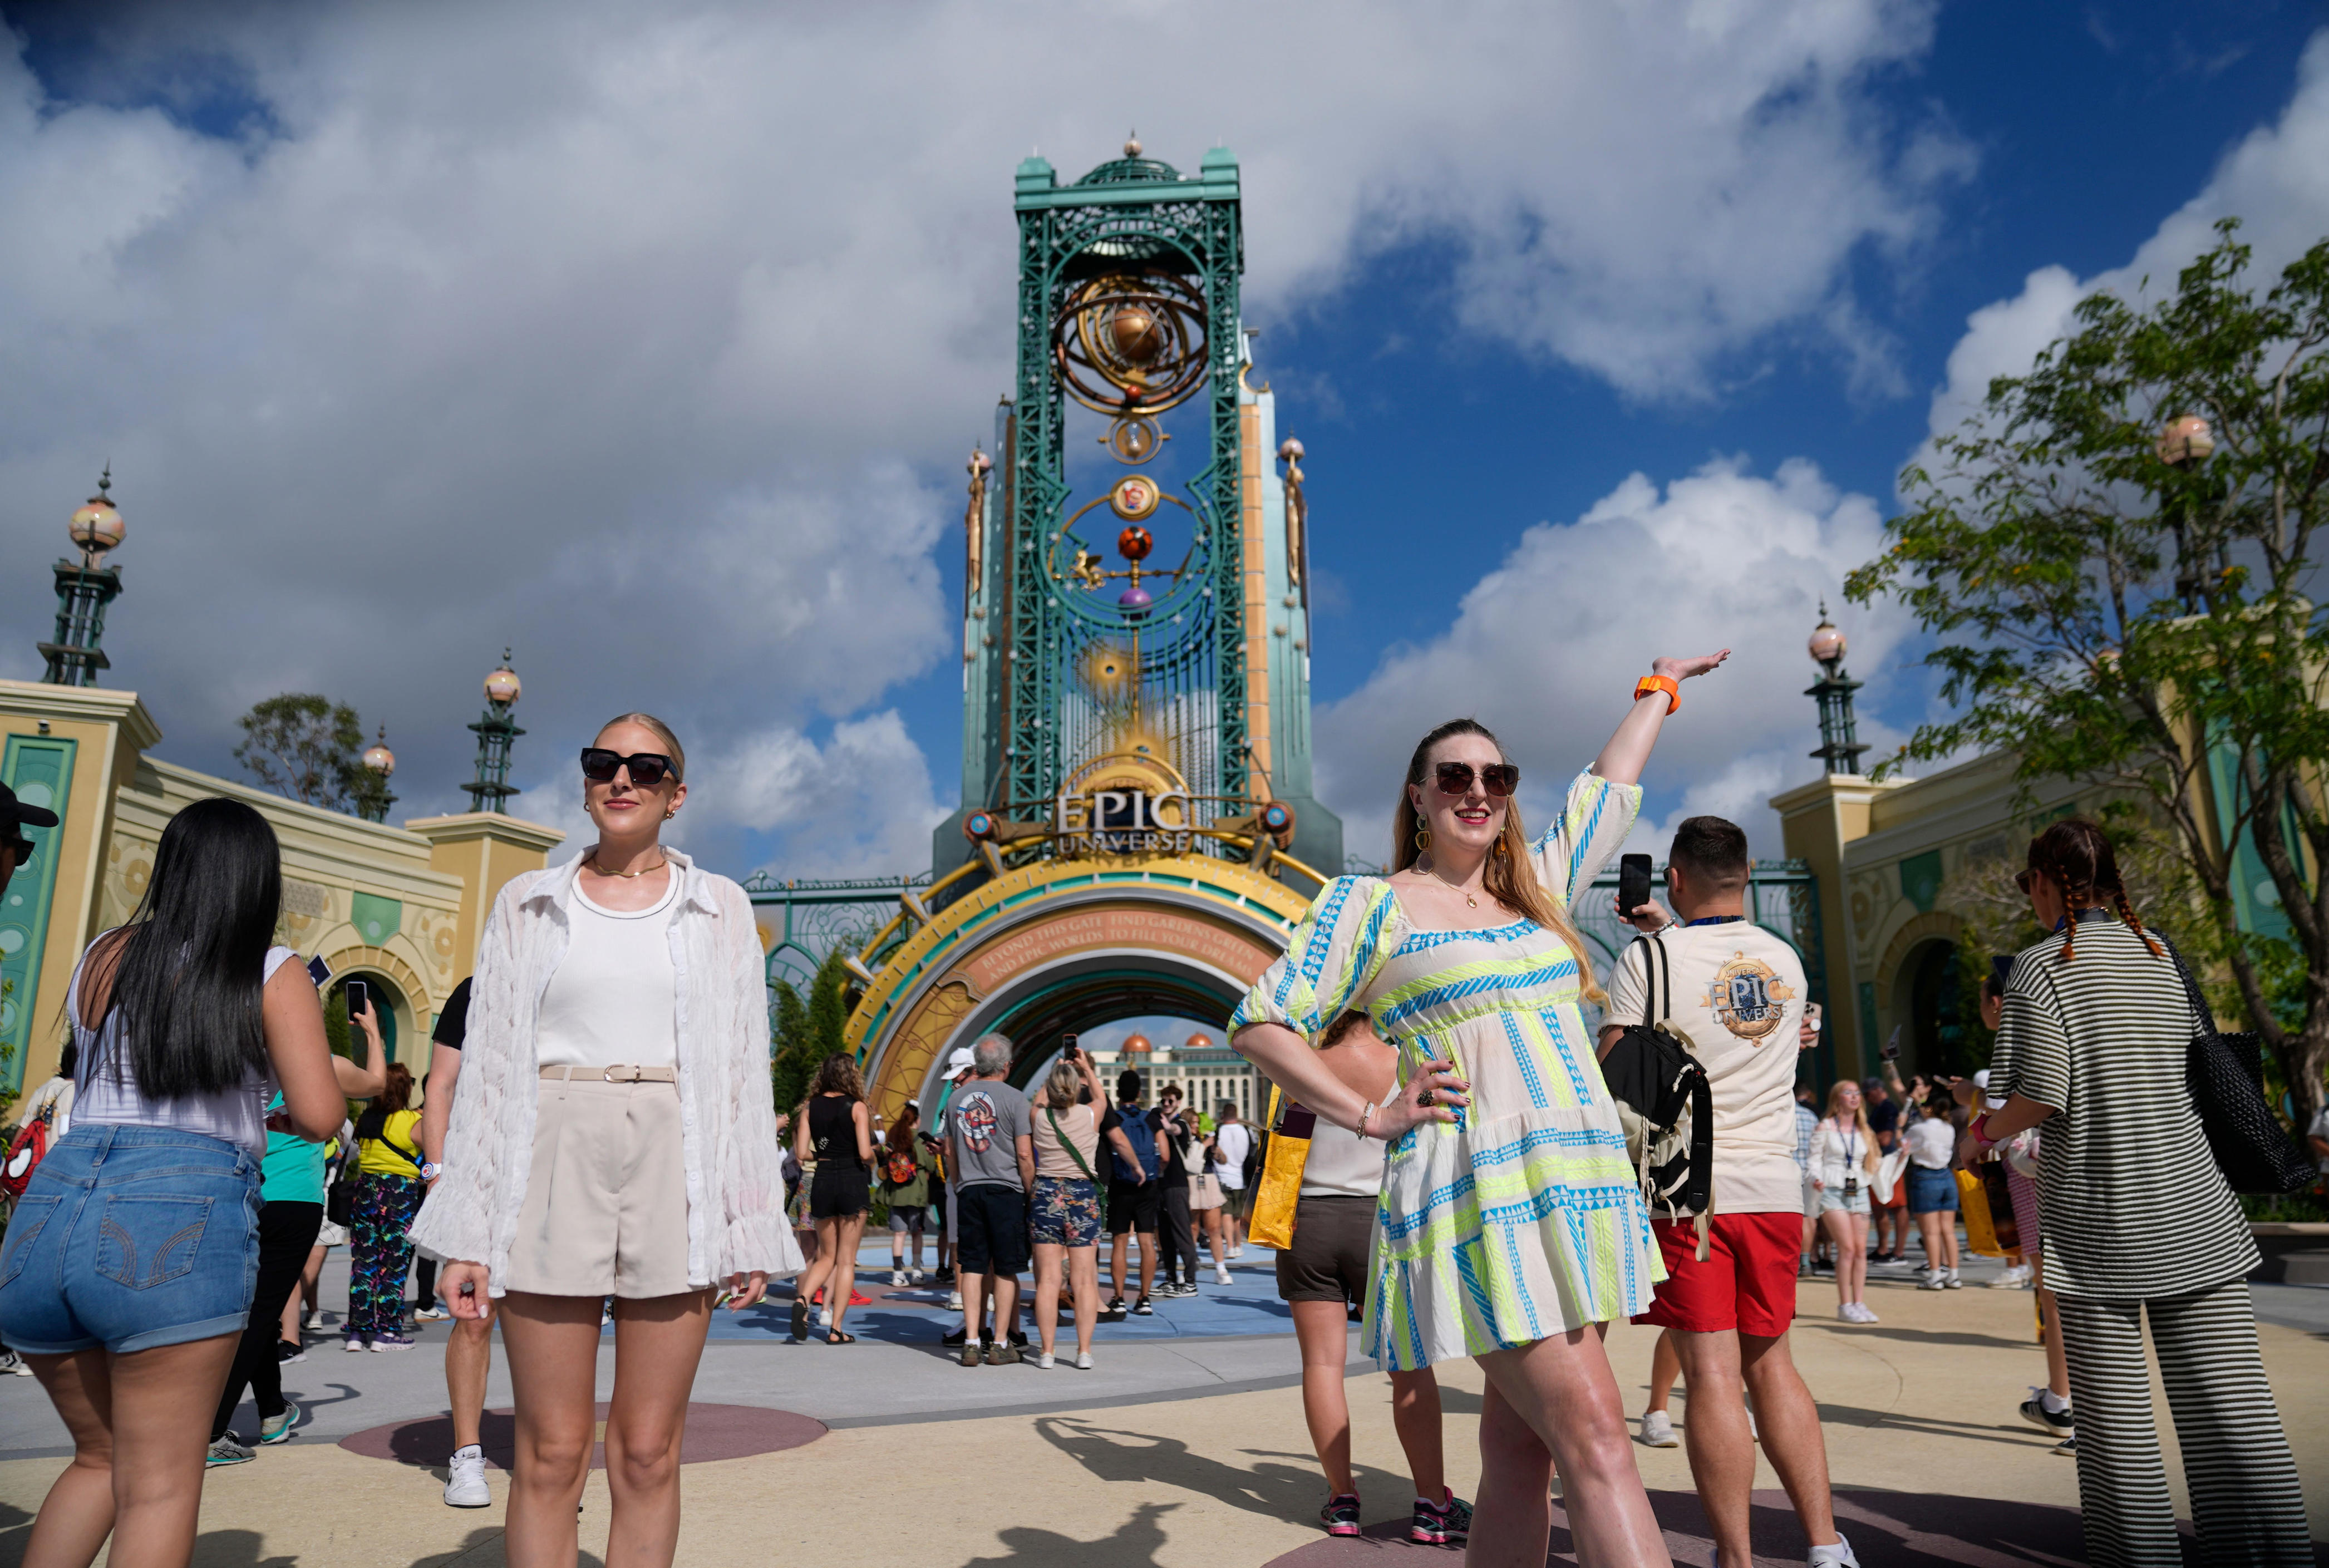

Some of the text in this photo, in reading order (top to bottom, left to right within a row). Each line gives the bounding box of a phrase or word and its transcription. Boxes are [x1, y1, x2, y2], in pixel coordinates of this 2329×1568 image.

[1056, 790, 1190, 834] EPIC
[1059, 832, 1189, 855] UNIVERSE
[982, 915, 1256, 969] BEYOND THIS GATE FIND GARDENS GREEN
[989, 929, 1253, 983] AND EPIC WORLDS TO FILL YOUR DREAMS
[1726, 967, 1765, 978] UNIVERSAL
[1705, 975, 1788, 1011] EPIC
[1712, 1006, 1789, 1024] UNIVERSE
